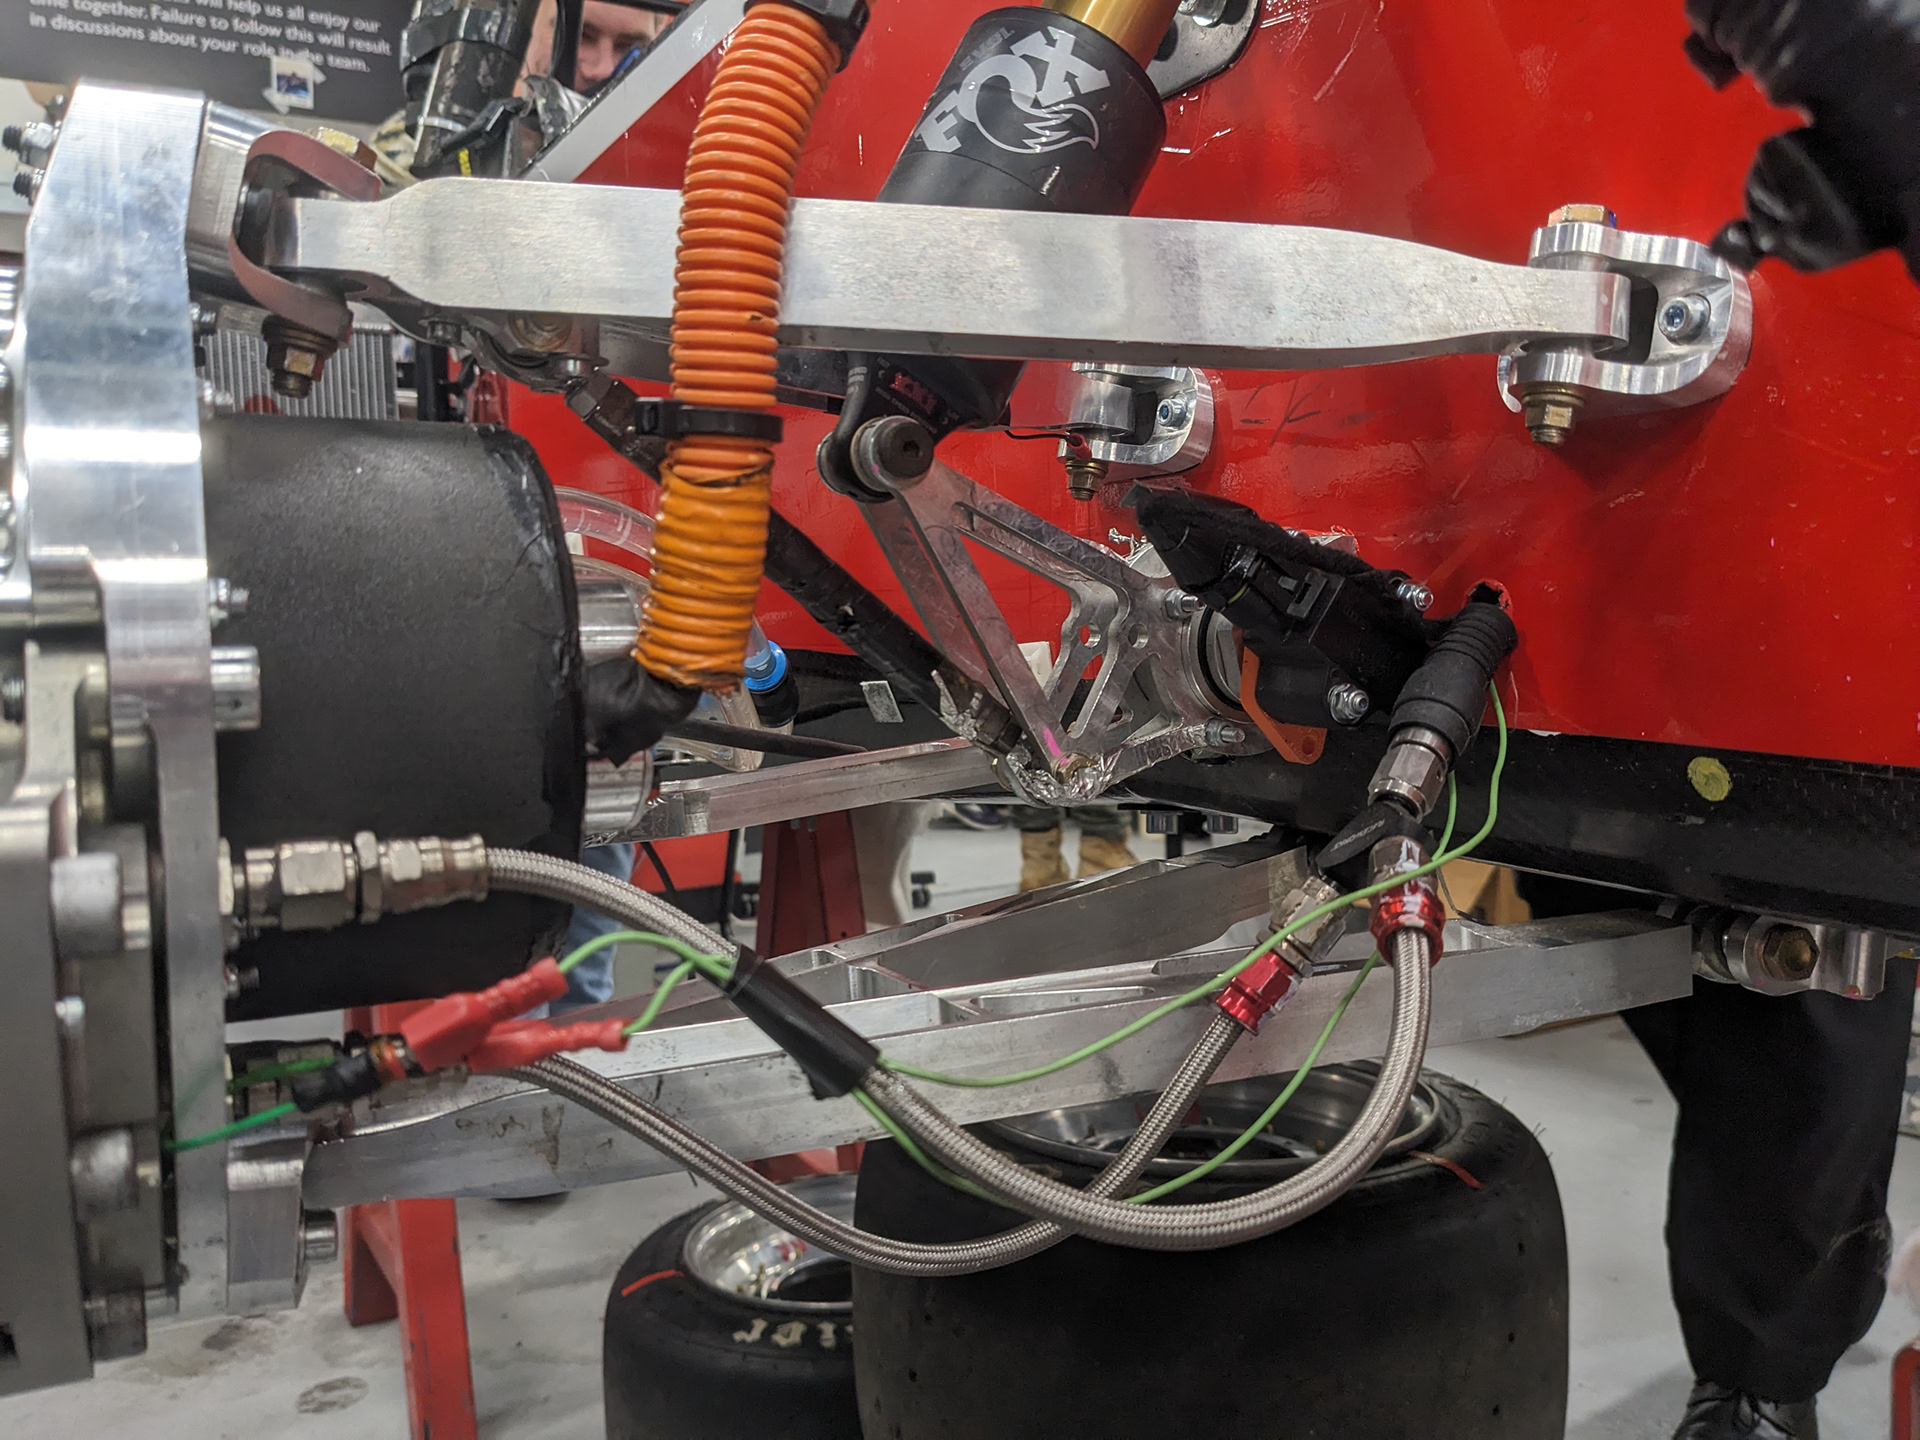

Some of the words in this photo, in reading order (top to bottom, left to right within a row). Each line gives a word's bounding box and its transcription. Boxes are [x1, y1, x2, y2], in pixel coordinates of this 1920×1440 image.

[29, 11, 47, 28] in
[49, 13, 146, 41] discussions
[148, 26, 198, 48] about
[200, 35, 240, 53] your
[242, 41, 276, 58] role
[326, 53, 371, 73] team.
[72, 0, 149, 20] together.
[150, 3, 207, 28] Failure
[209, 15, 230, 31] to
[231, 15, 282, 38] follow
[285, 25, 315, 44] this
[317, 31, 346, 49] will
[348, 36, 392, 56] result
[227, 0, 262, 17] help
[264, 5, 284, 19] us
[286, 5, 304, 22] all
[307, 10, 350, 32] enjoy
[352, 17, 382, 34] our
[914, 25, 1111, 154] FOX
